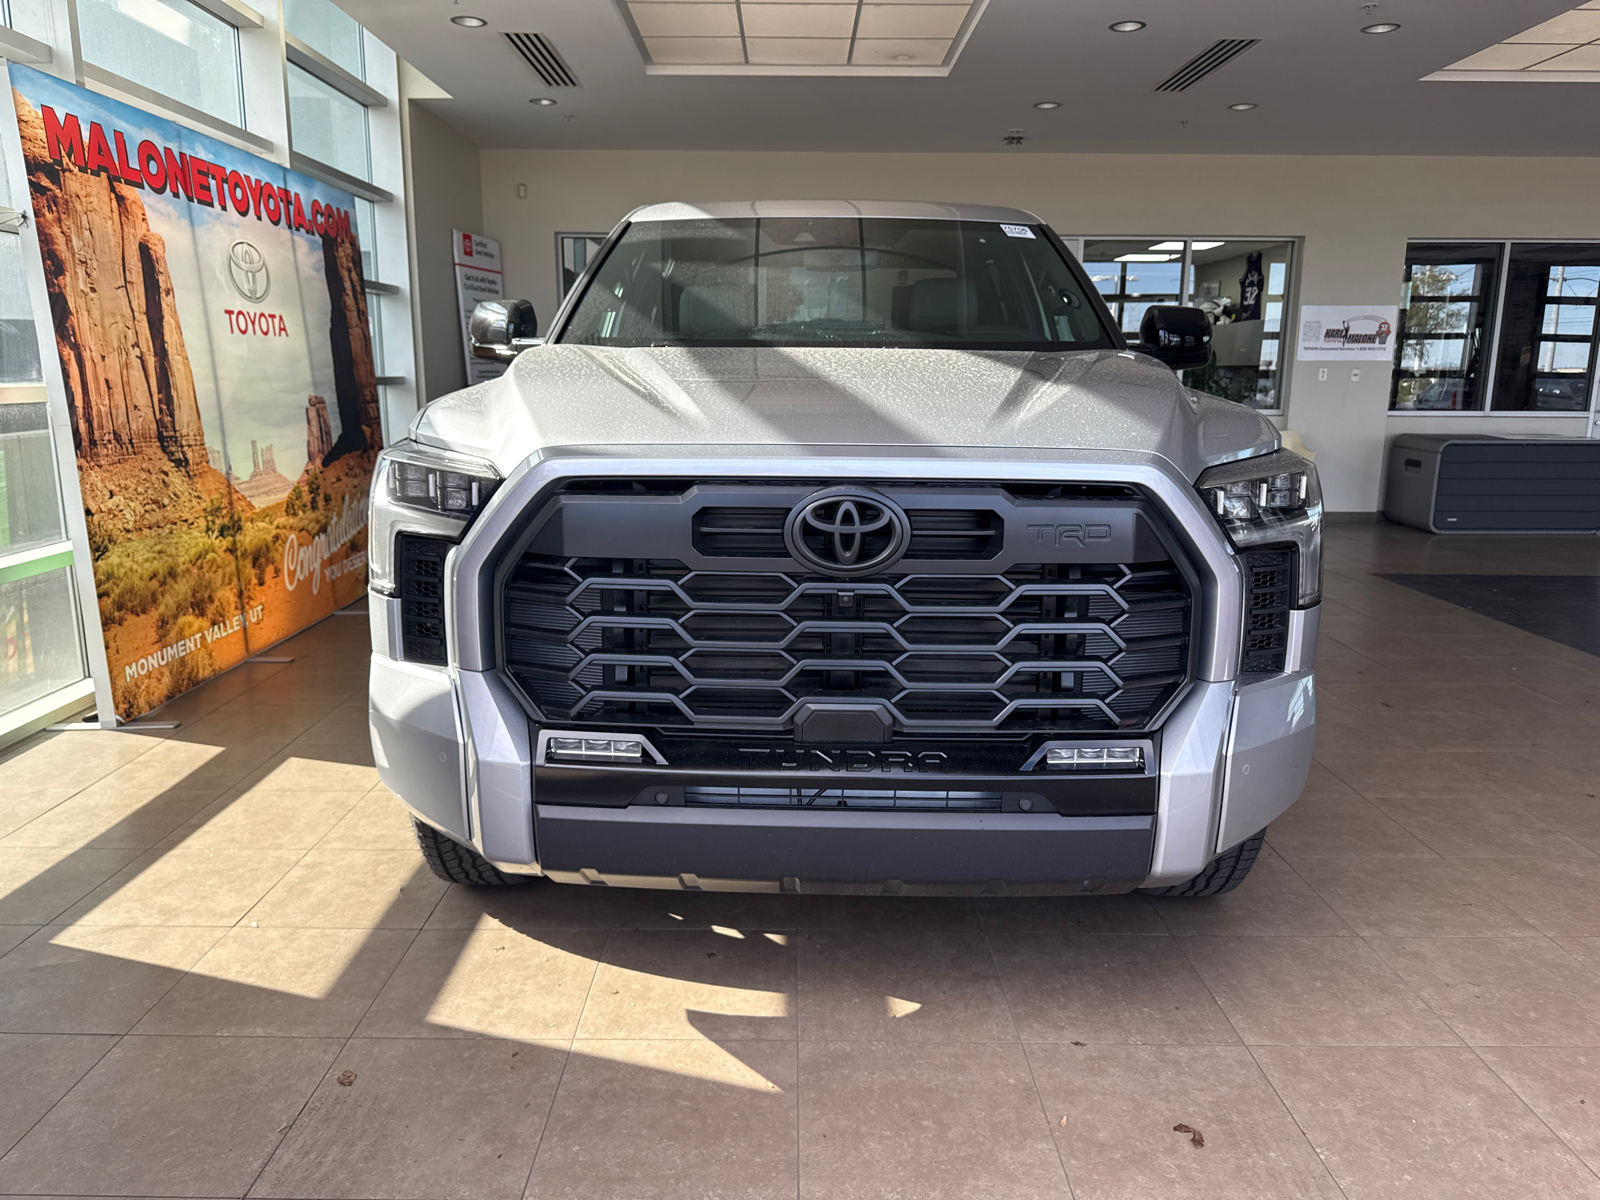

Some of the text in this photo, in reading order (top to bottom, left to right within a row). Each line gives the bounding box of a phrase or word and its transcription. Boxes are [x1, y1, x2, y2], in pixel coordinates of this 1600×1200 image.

[40, 104, 351, 241] MALONETOYOTA.COM
[1243, 286, 1258, 305] 32
[224, 309, 289, 338] TOYOTA
[1324, 328, 1344, 338] KARL
[1346, 334, 1377, 344] MALONE
[1026, 524, 1111, 547] TRD
[324, 562, 342, 582] YOU
[124, 632, 202, 683] MONUMENT
[249, 604, 264, 624] UT
[738, 748, 948, 772] TUNDRA
